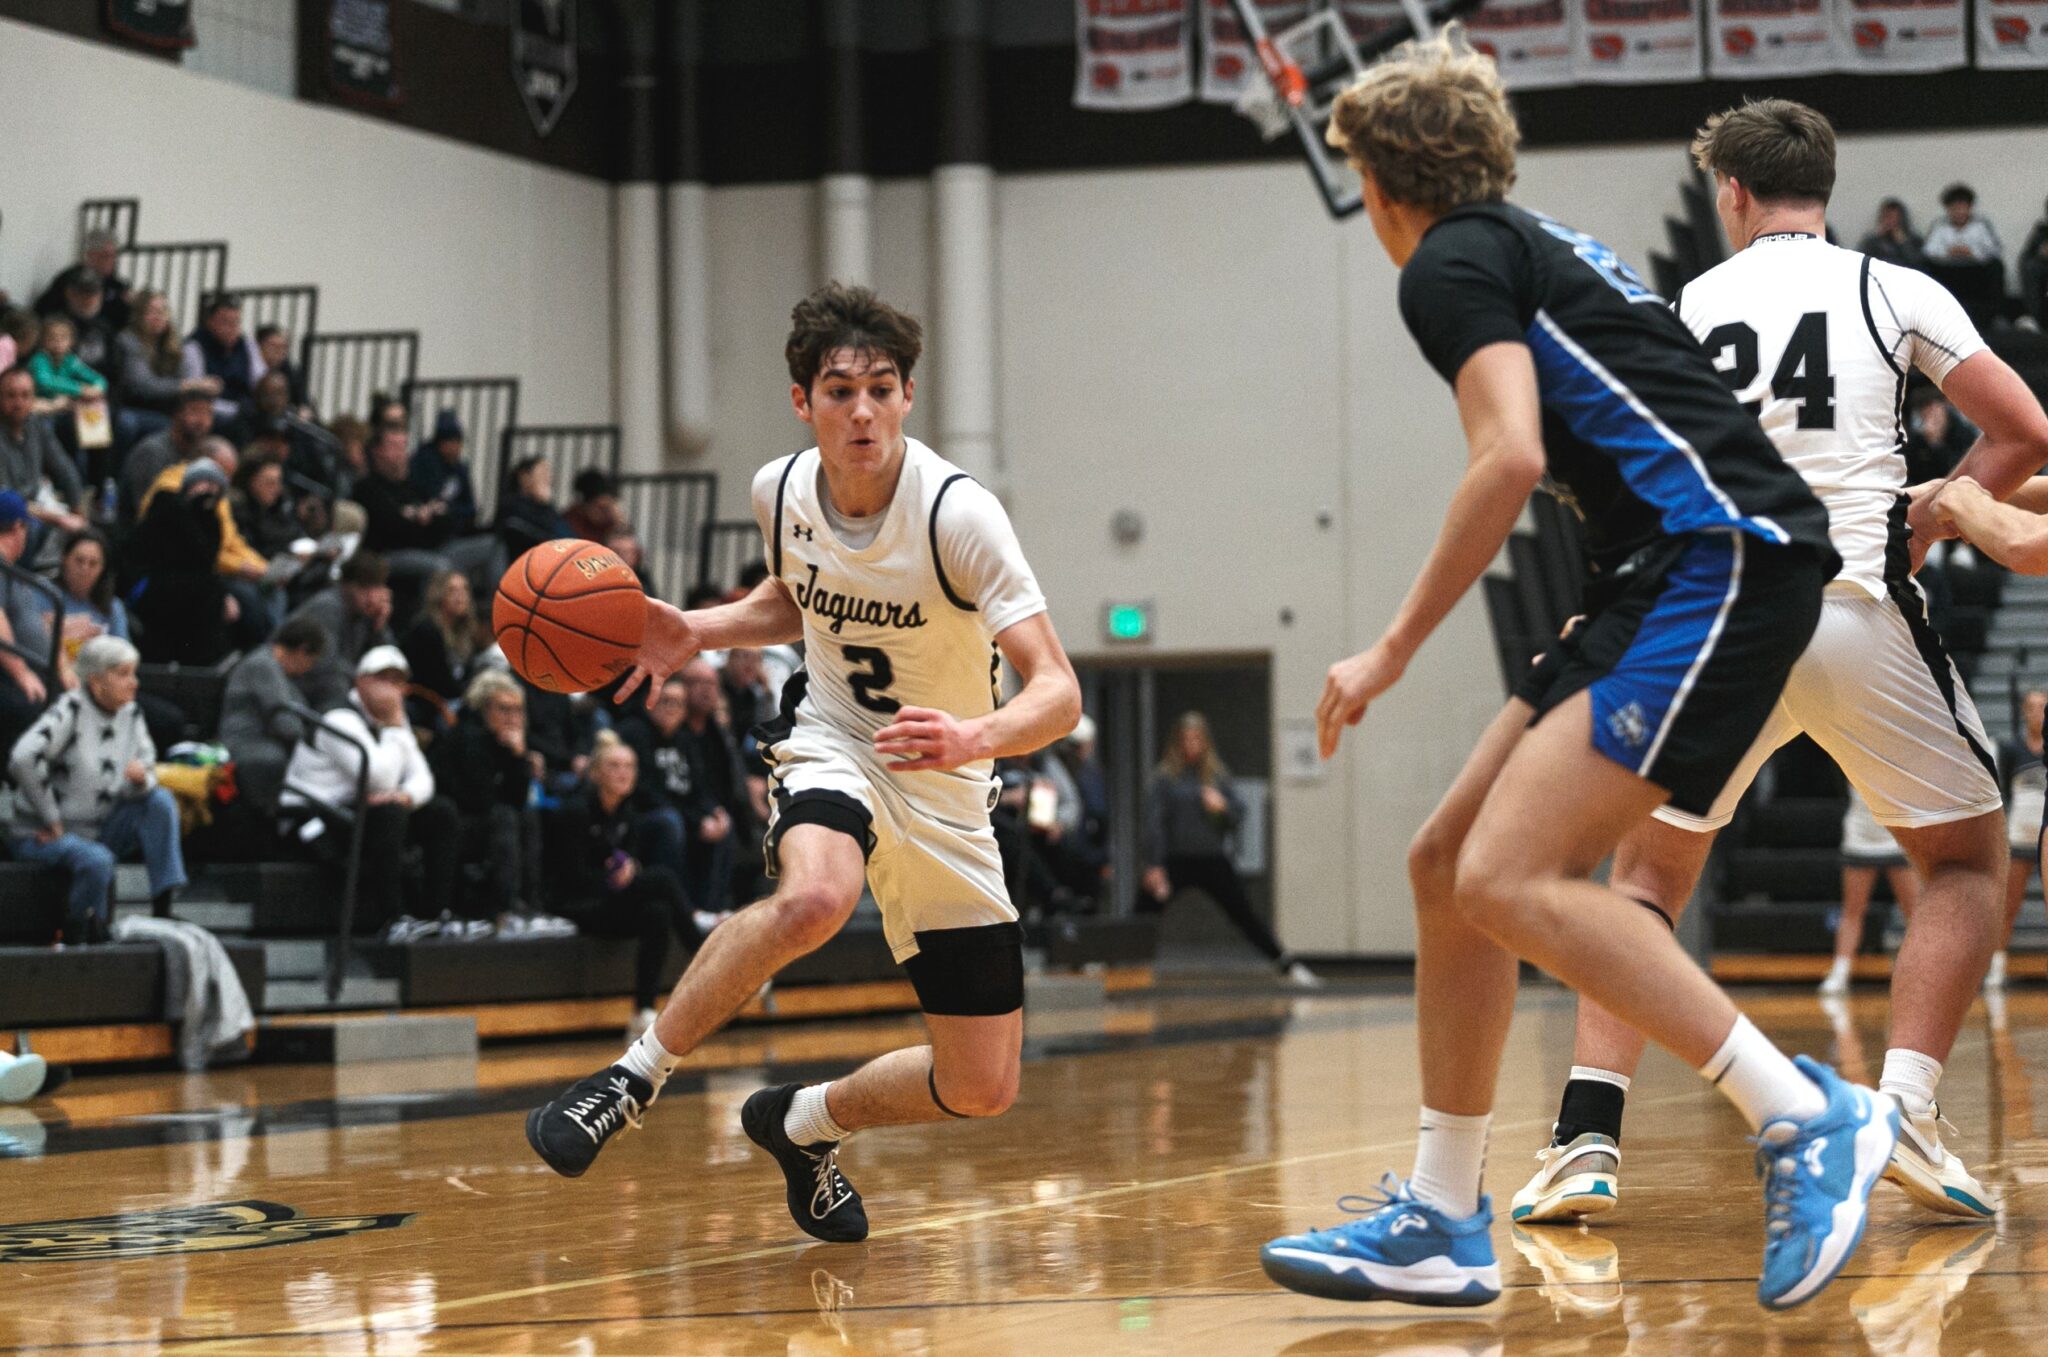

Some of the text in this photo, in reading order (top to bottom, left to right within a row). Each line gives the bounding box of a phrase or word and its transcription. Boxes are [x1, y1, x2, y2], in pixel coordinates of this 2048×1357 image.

[1700, 310, 1837, 432] 24
[796, 563, 928, 635] Jaguars
[841, 644, 902, 714] 2
